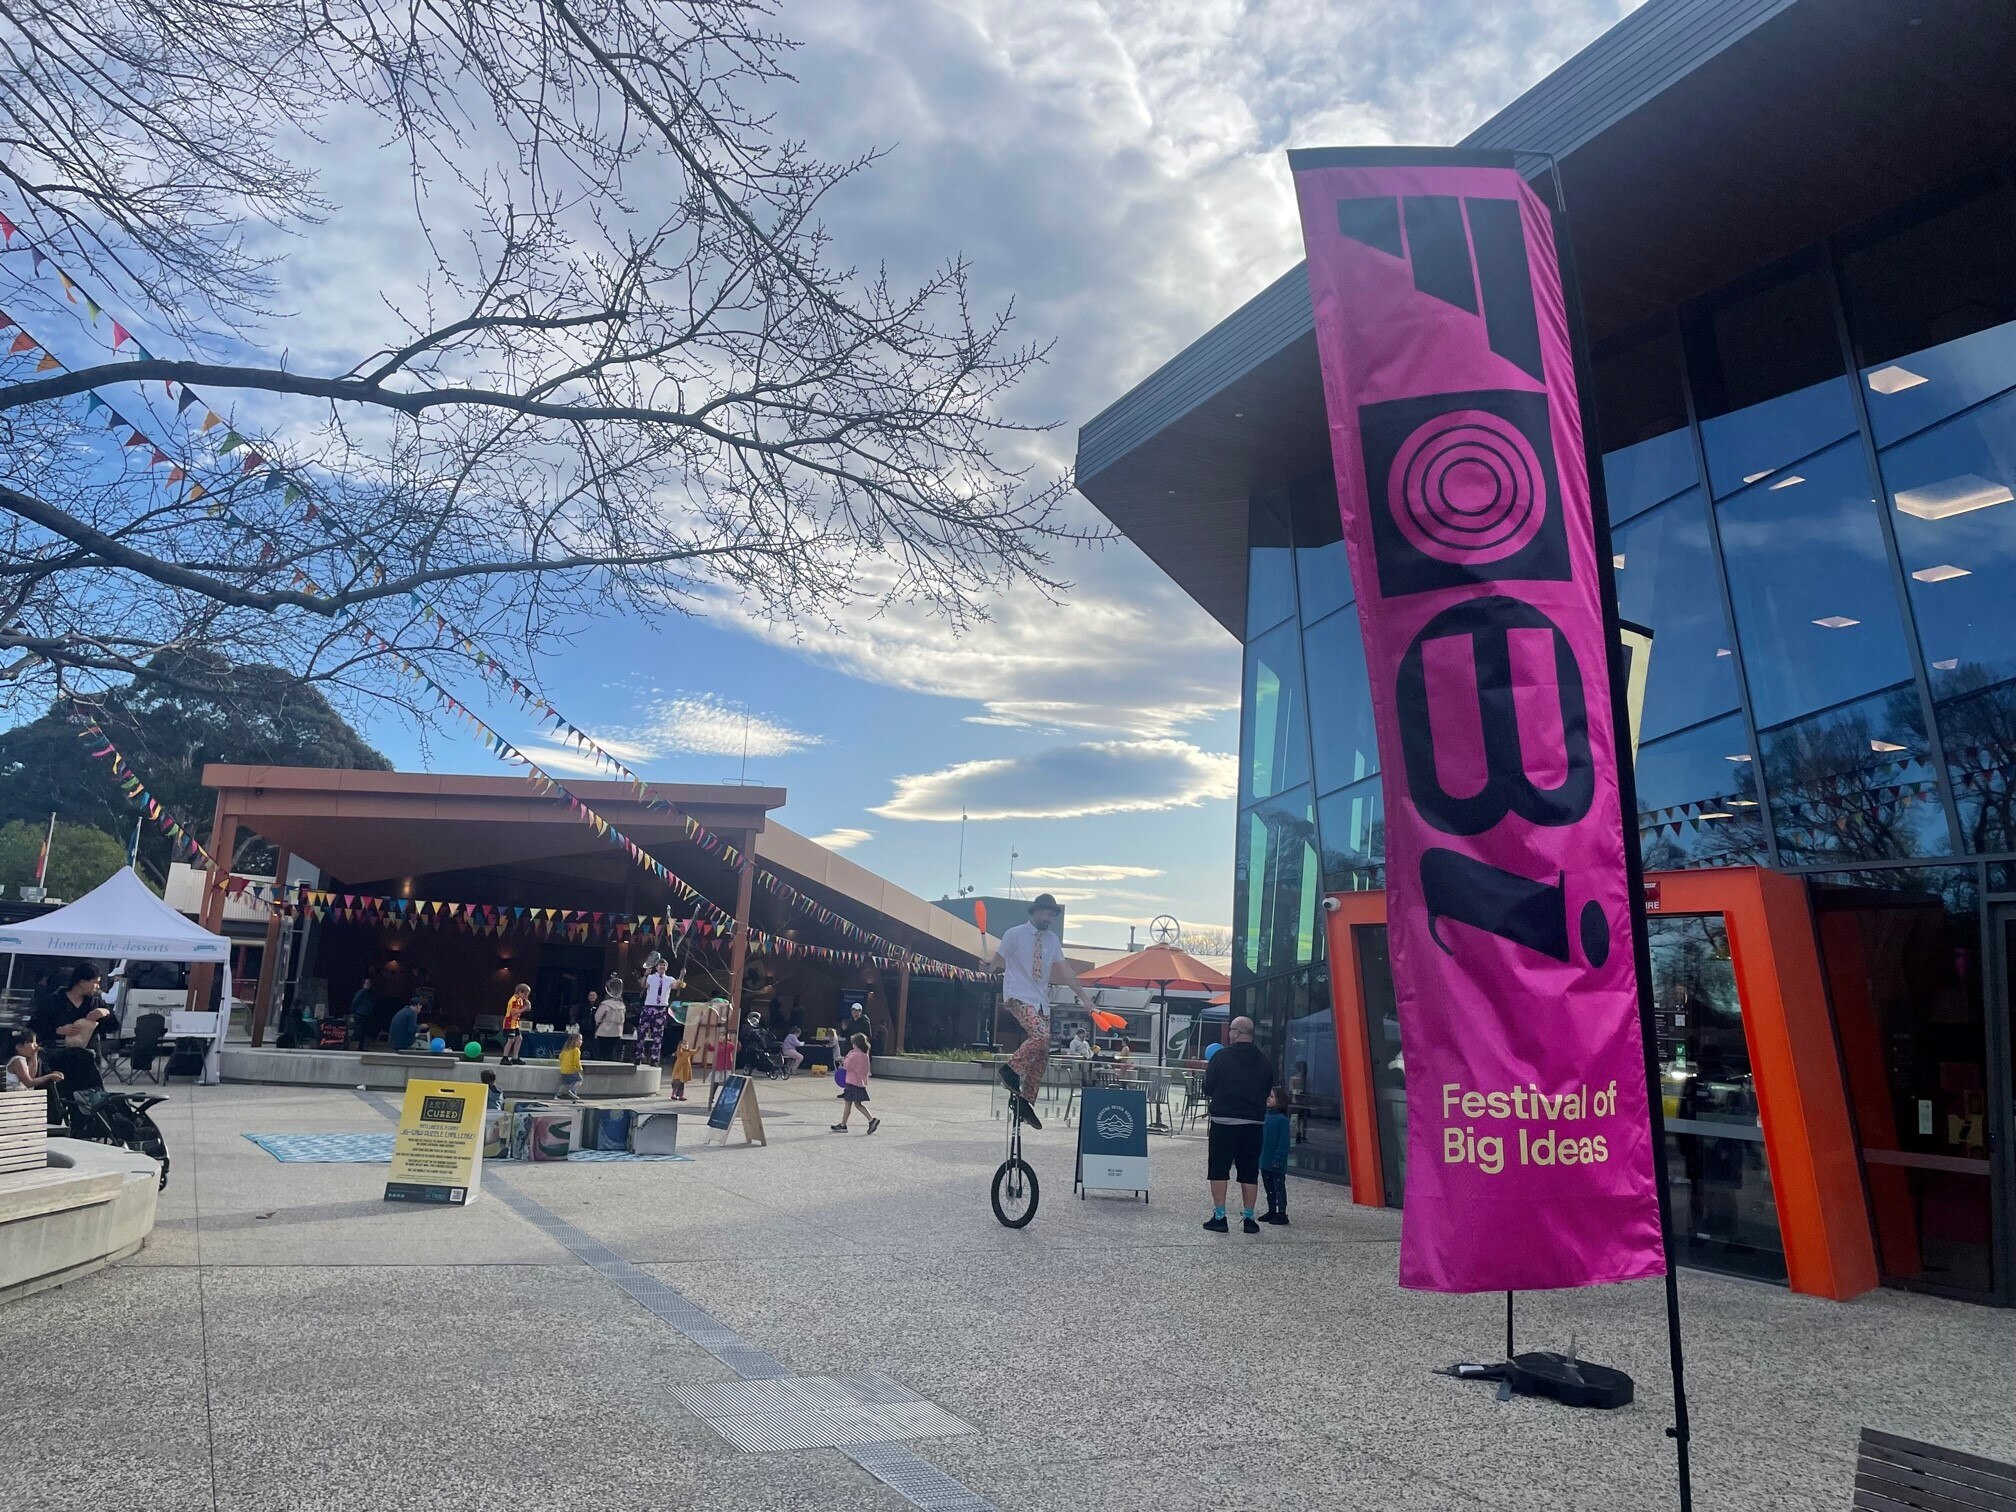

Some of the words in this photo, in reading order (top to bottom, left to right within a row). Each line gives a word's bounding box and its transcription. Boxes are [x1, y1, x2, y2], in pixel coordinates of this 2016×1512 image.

[1644, 901, 1660, 910] IRE
[47, 937, 118, 951] Homemade
[122, 940, 169, 953] desserts
[1442, 1083, 1587, 1121] Festival
[1593, 1080, 1617, 1117] of
[426, 1109, 458, 1119] CUBED
[1444, 1126, 1505, 1174] Big
[1519, 1128, 1609, 1165] Ideas
